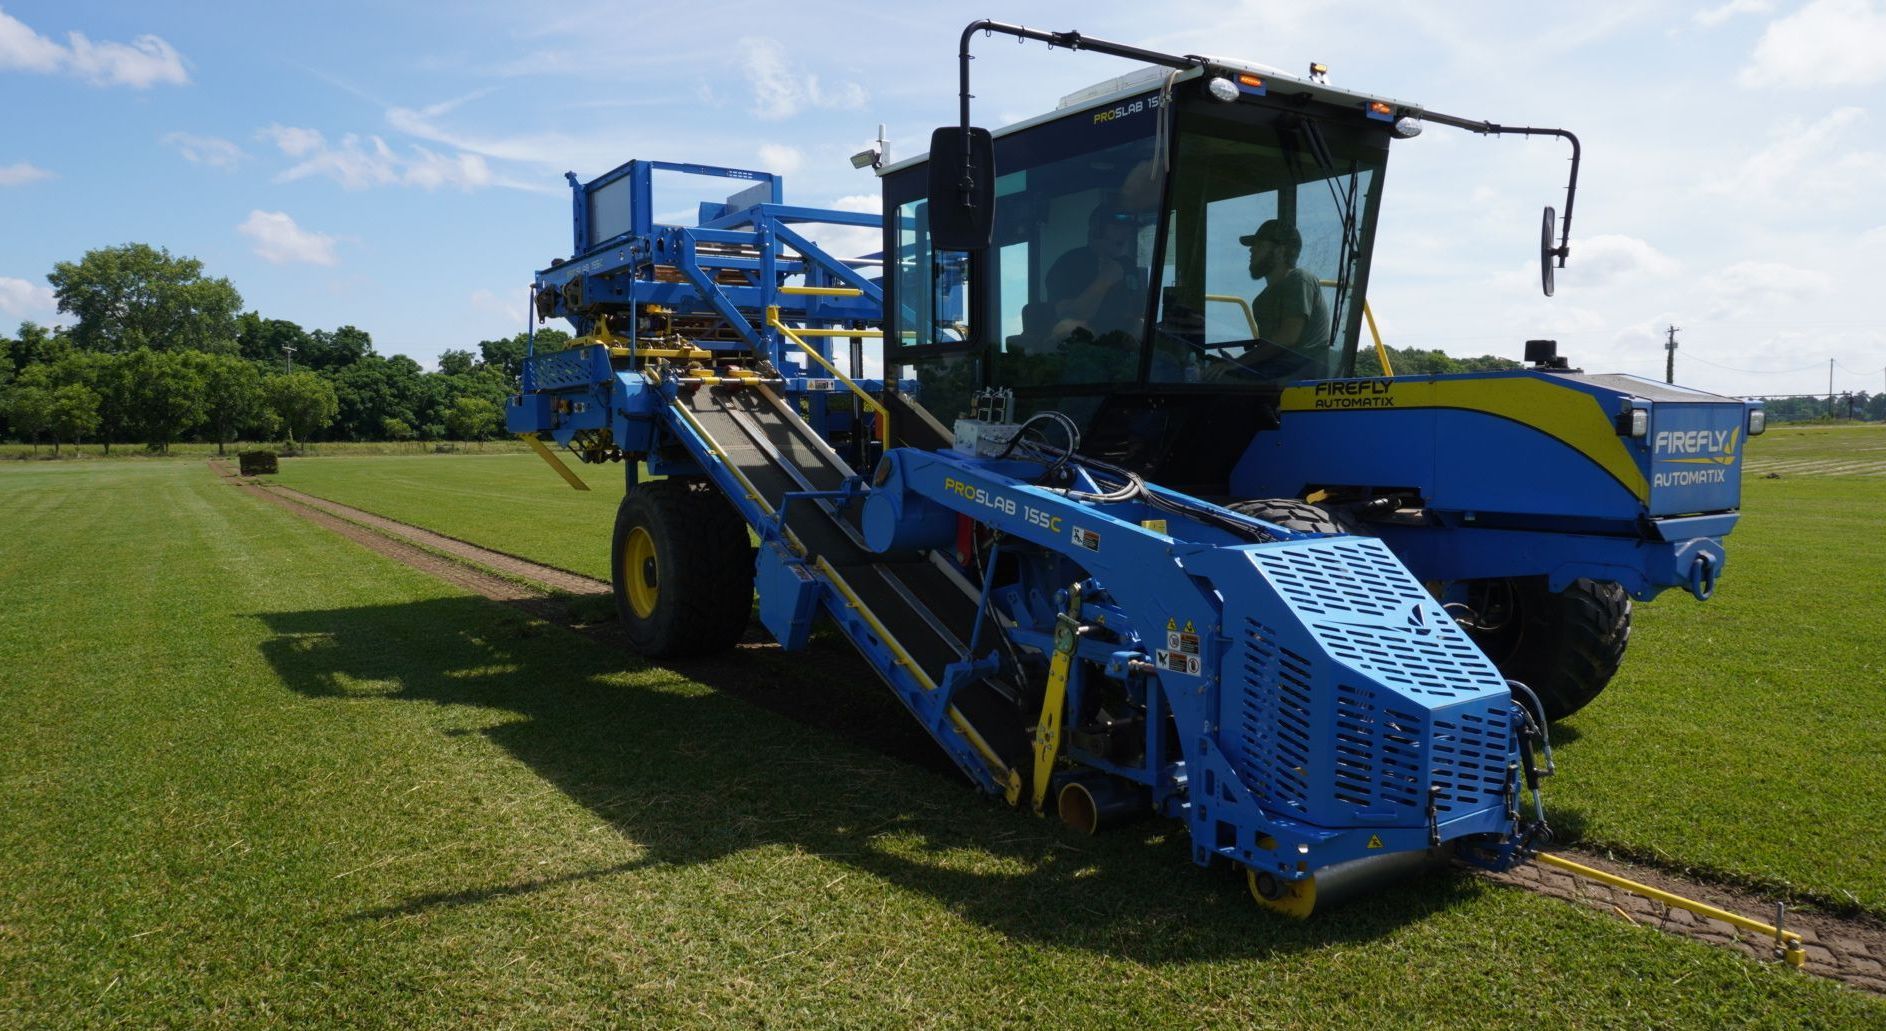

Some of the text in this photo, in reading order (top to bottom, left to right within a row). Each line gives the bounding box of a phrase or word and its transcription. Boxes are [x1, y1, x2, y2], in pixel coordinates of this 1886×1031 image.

[1094, 95, 1165, 123] PROSLAB 15
[1315, 380, 1393, 396] FIREFLY
[1315, 397, 1394, 408] AUTOMATIX
[1655, 430, 1727, 454] FIREFLY
[1654, 469, 1725, 488] AUTOMATIX
[945, 478, 1062, 532] PROSLAB 155C
